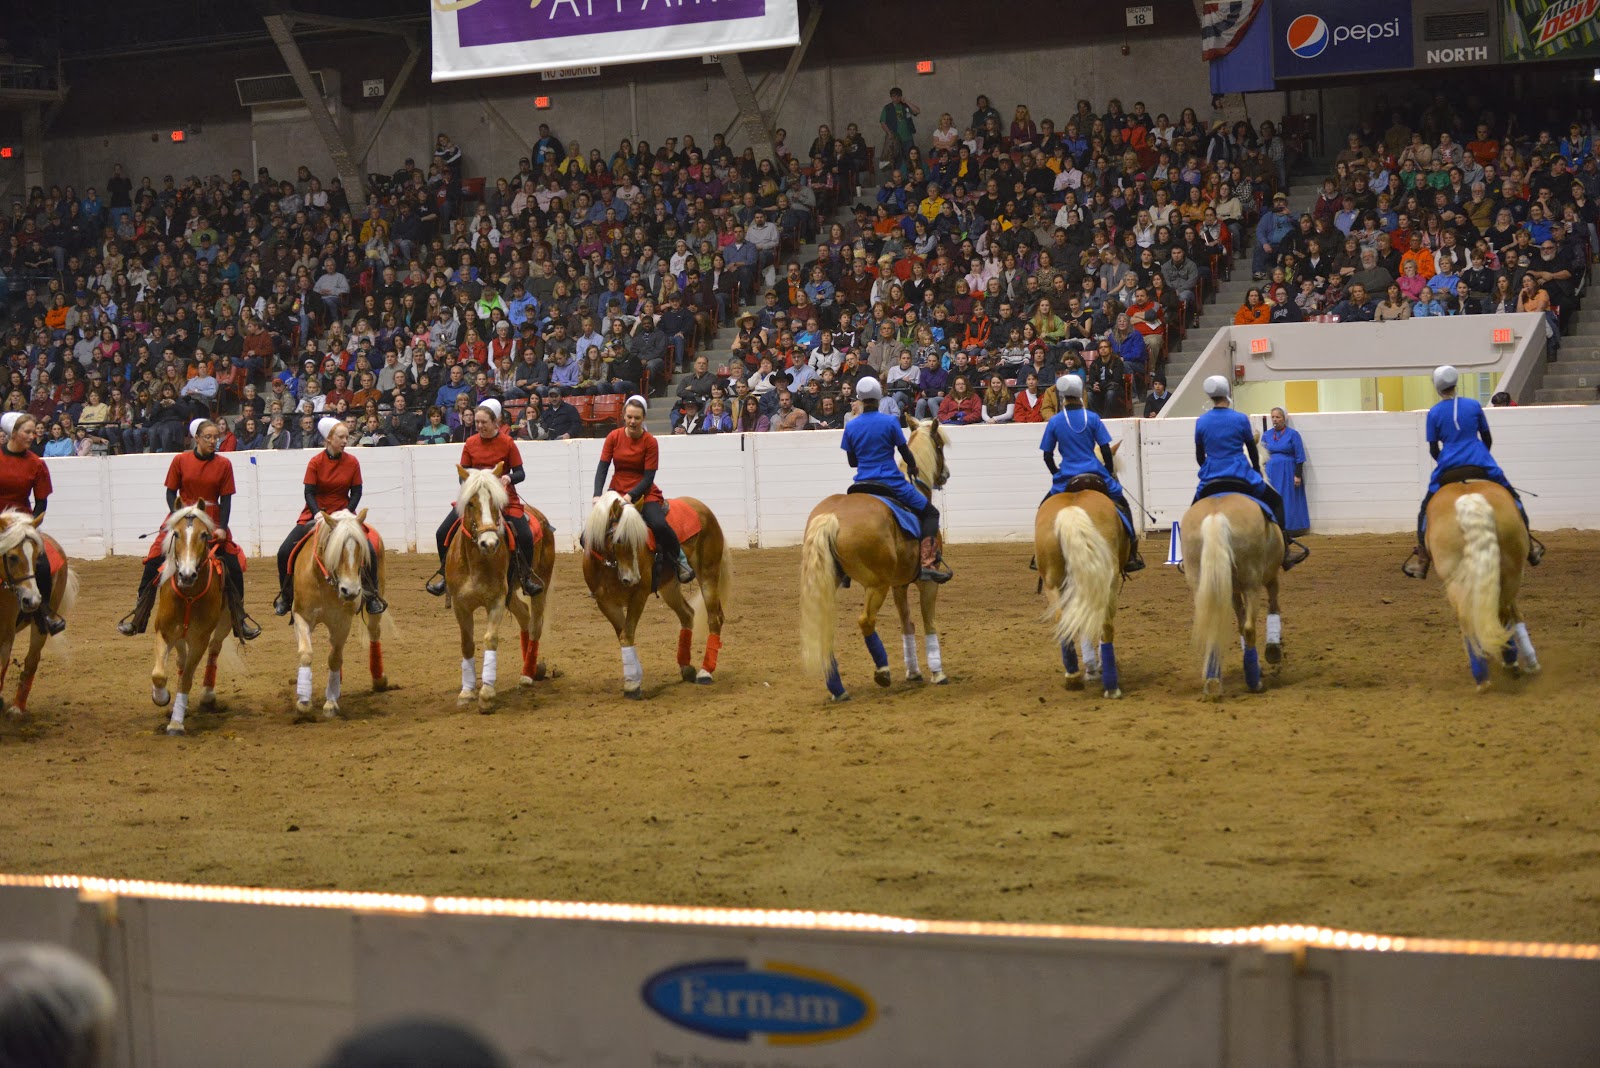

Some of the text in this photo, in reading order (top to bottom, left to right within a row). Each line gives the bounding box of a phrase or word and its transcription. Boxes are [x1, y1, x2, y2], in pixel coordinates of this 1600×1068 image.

[1127, 6, 1152, 14] SECTION
[1133, 14, 1146, 24] 18
[1333, 17, 1400, 46] pepsi
[1427, 46, 1488, 64] NORTH
[368, 86, 380, 96] 20
[1494, 329, 1510, 342] EXIT
[1251, 339, 1267, 353] EXIT
[679, 976, 840, 1025] Farnam
